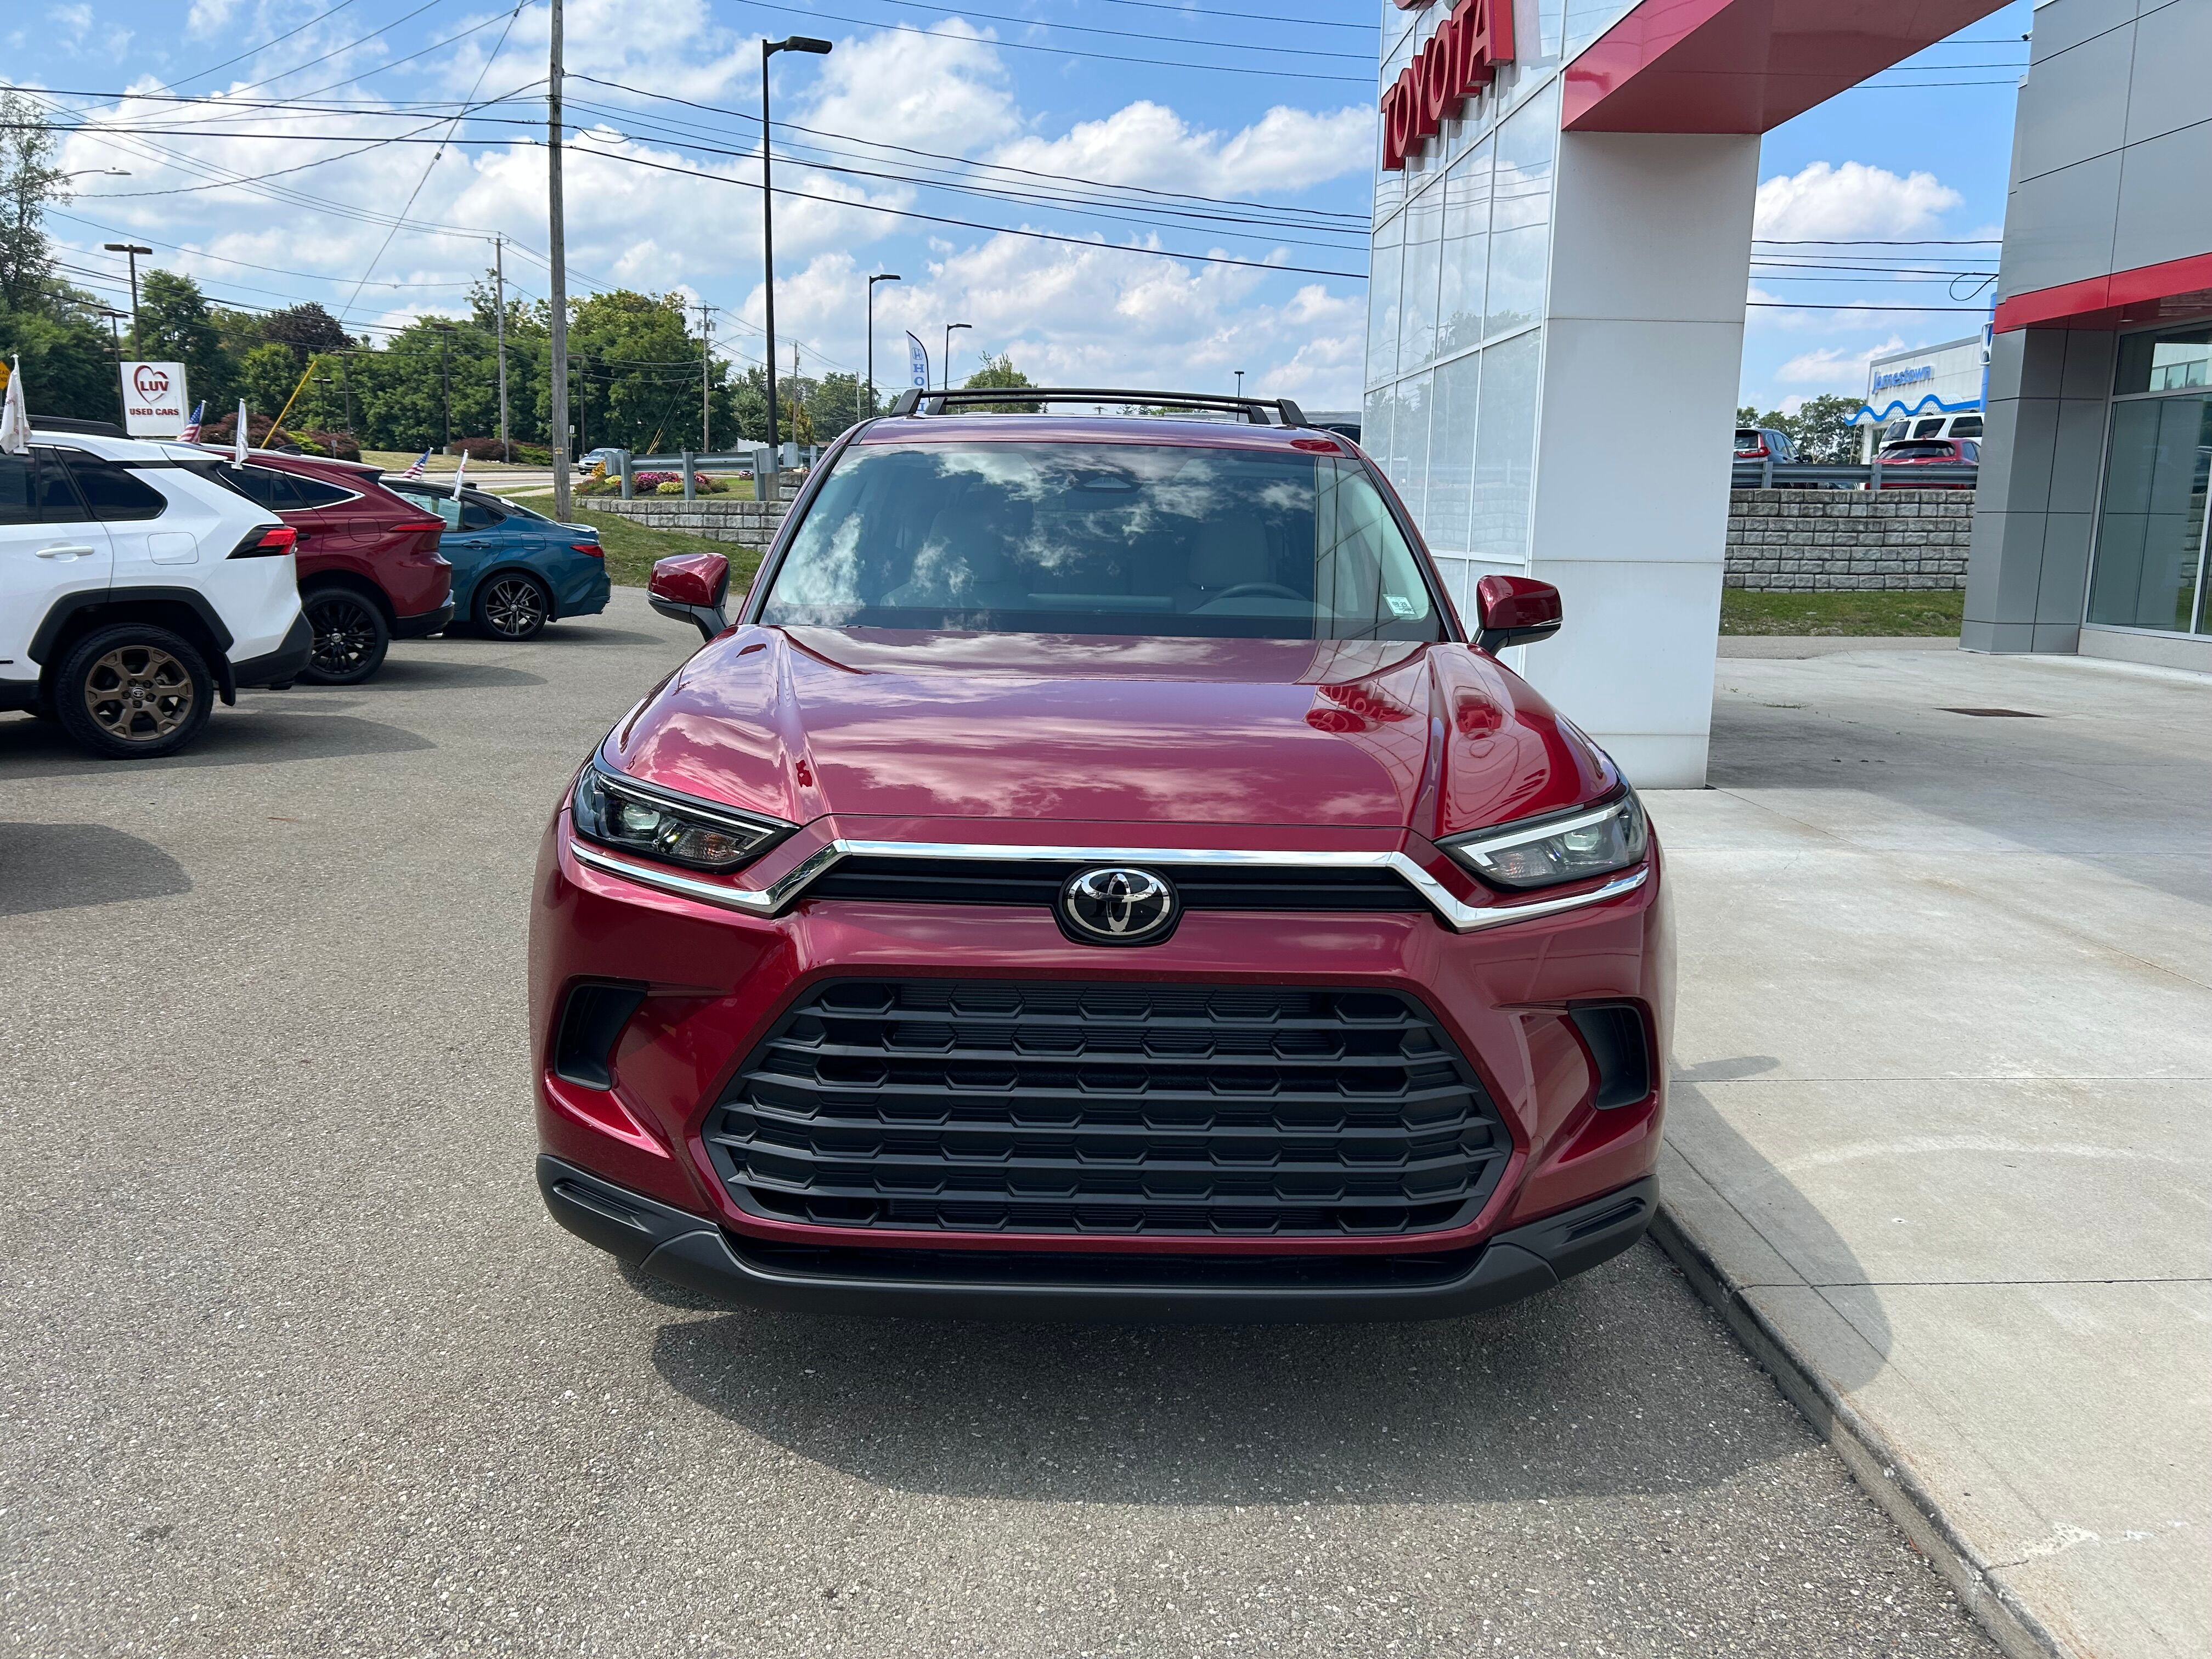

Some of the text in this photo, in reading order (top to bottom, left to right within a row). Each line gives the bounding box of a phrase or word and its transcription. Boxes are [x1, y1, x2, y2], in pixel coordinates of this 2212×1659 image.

[1380, 0, 1514, 171] TOYOTA
[140, 381, 169, 391] LUV
[1871, 365, 1932, 395] Jamestown
